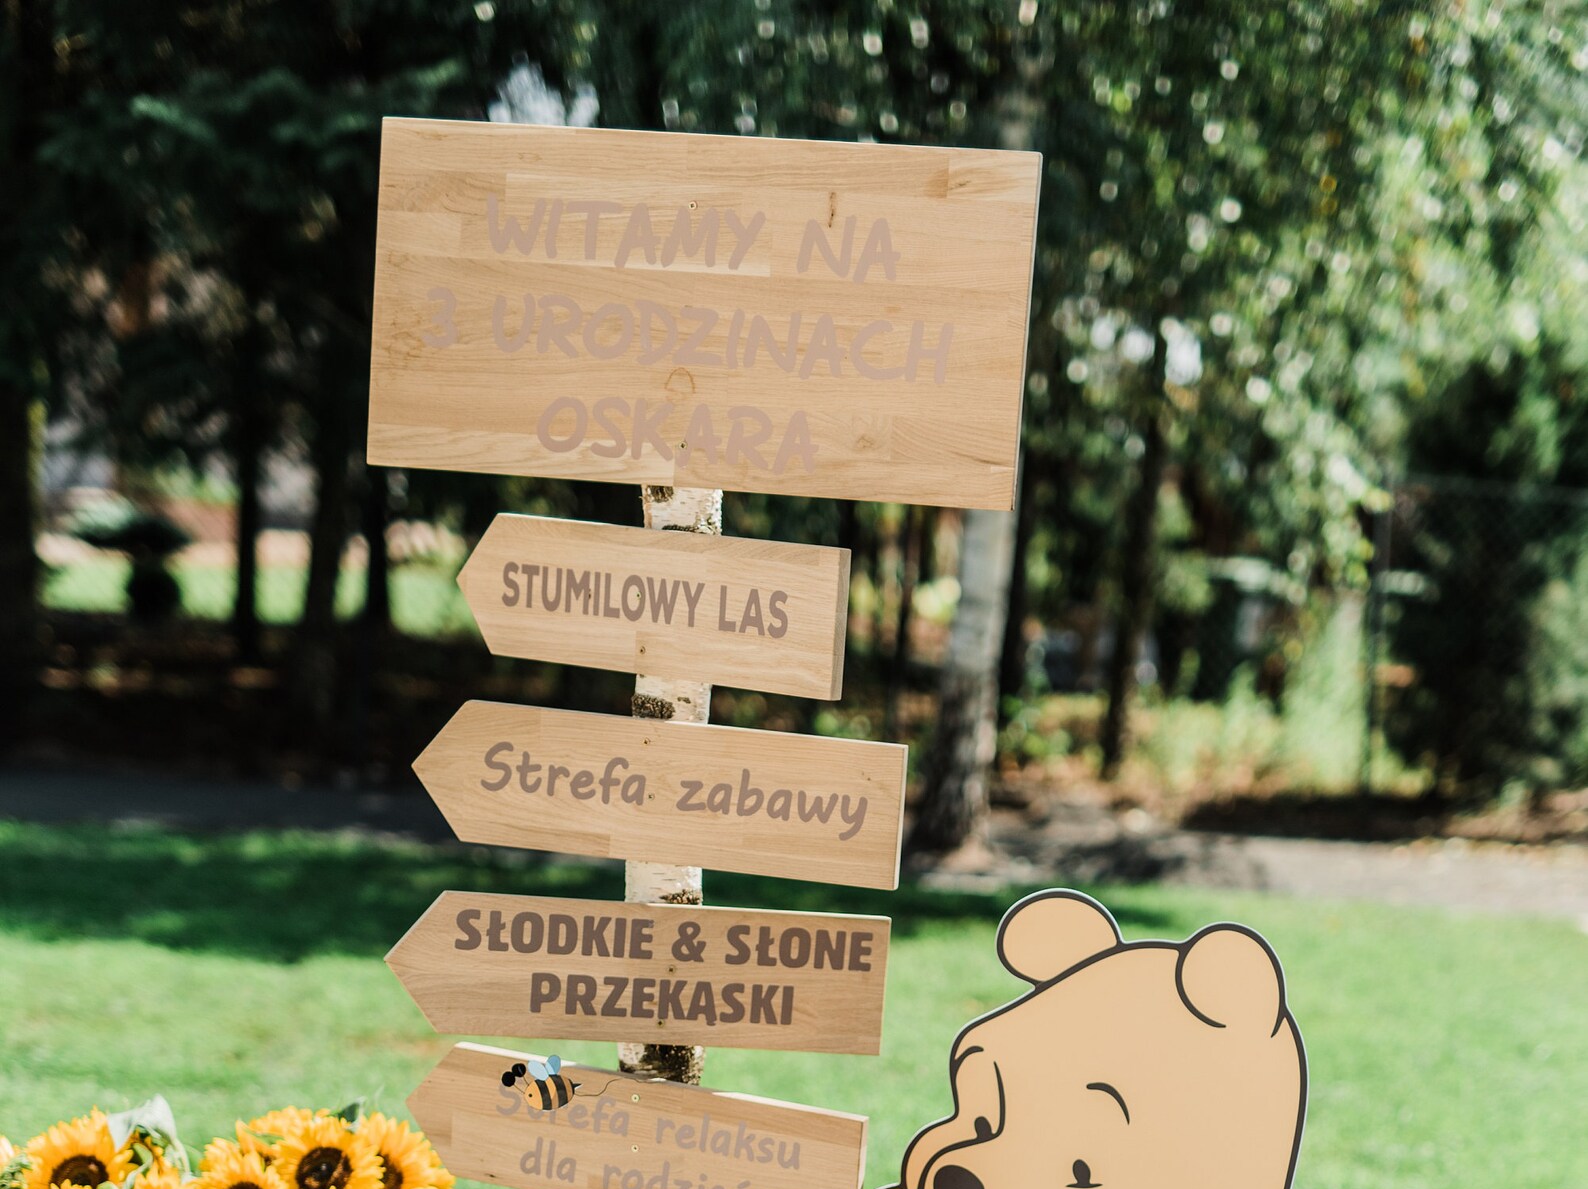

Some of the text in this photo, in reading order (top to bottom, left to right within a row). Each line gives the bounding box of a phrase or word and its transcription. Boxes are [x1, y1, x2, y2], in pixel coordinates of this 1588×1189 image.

[487, 195, 900, 283] WITAMY NA
[421, 287, 955, 384] 3 URODZINACH
[536, 396, 819, 475] OSKARA
[501, 561, 788, 639] STUMILOWY LAS
[480, 741, 869, 842] Strefa zabawy
[454, 908, 873, 972] SŁODKIE & SŁONE
[529, 972, 795, 1026] PRZEKĄSKI
[519, 1136, 577, 1183] dla
[655, 1111, 801, 1170] relaksu
